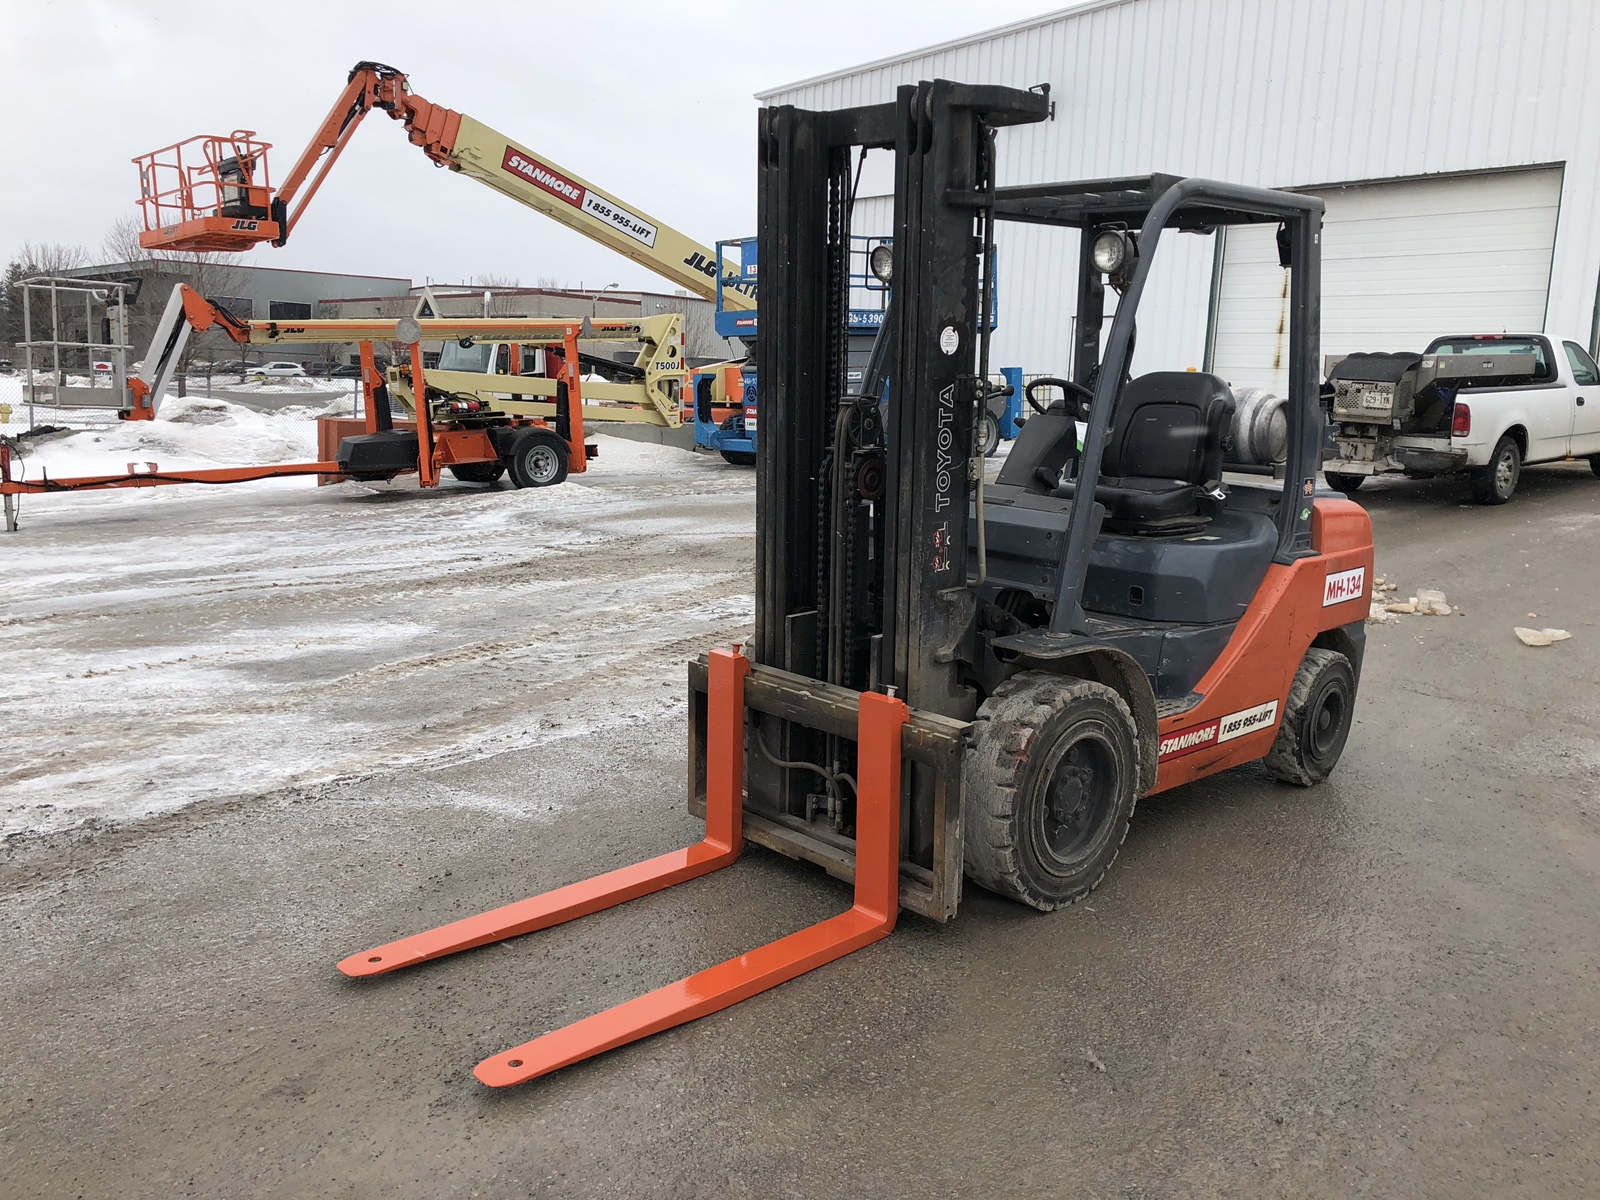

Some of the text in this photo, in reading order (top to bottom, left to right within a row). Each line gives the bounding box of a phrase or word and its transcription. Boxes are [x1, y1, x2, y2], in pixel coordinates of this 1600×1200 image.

[508, 155, 652, 238] STANMORE 1 855 955-LIFT
[229, 219, 259, 231] JLG
[682, 250, 717, 279] JLG
[655, 361, 680, 370] T500J
[935, 383, 955, 513] TOYOTA
[1326, 575, 1361, 600] MH-134
[1158, 708, 1274, 757] STANMORE 1 855 955-LIFT
